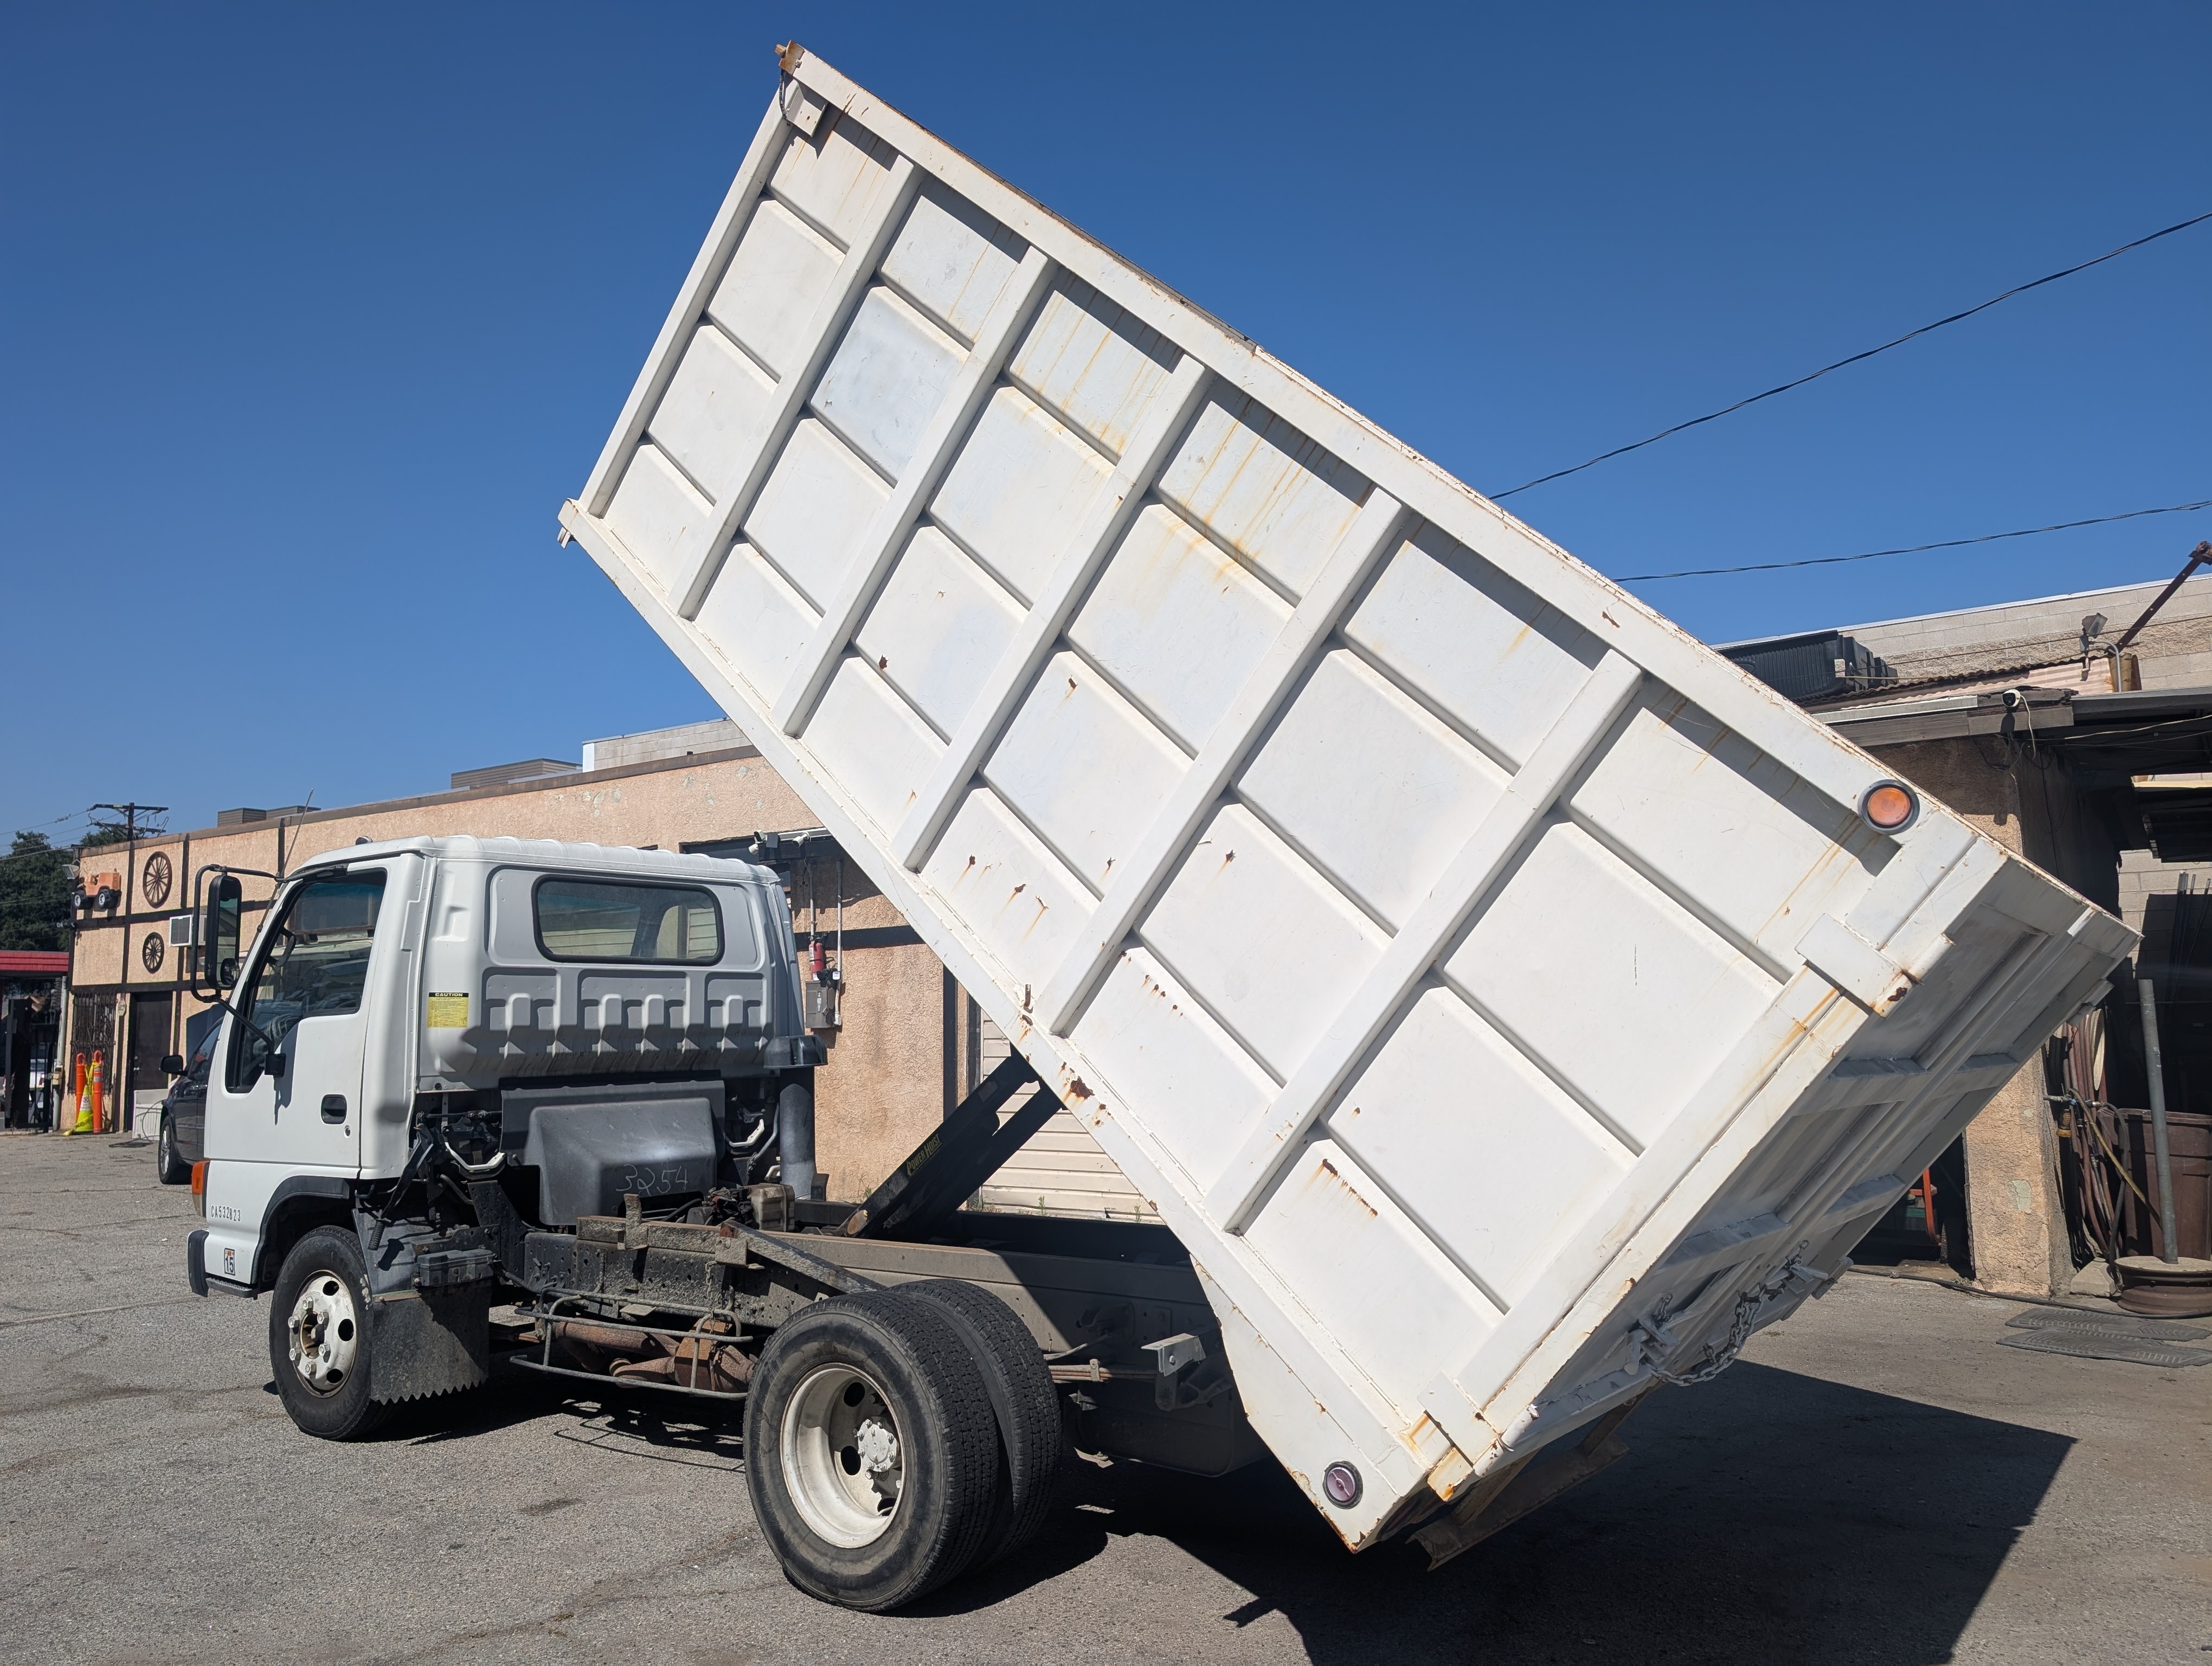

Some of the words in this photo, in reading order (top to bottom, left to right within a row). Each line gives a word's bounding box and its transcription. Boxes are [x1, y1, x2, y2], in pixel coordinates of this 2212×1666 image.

[906, 1150, 926, 1176] POWER
[924, 1133, 942, 1157] HOIST
[616, 1163, 689, 1197] 3254
[211, 1205, 241, 1222] CA532823
[225, 1256, 234, 1273] 15
[764, 1349, 785, 1388] HT
